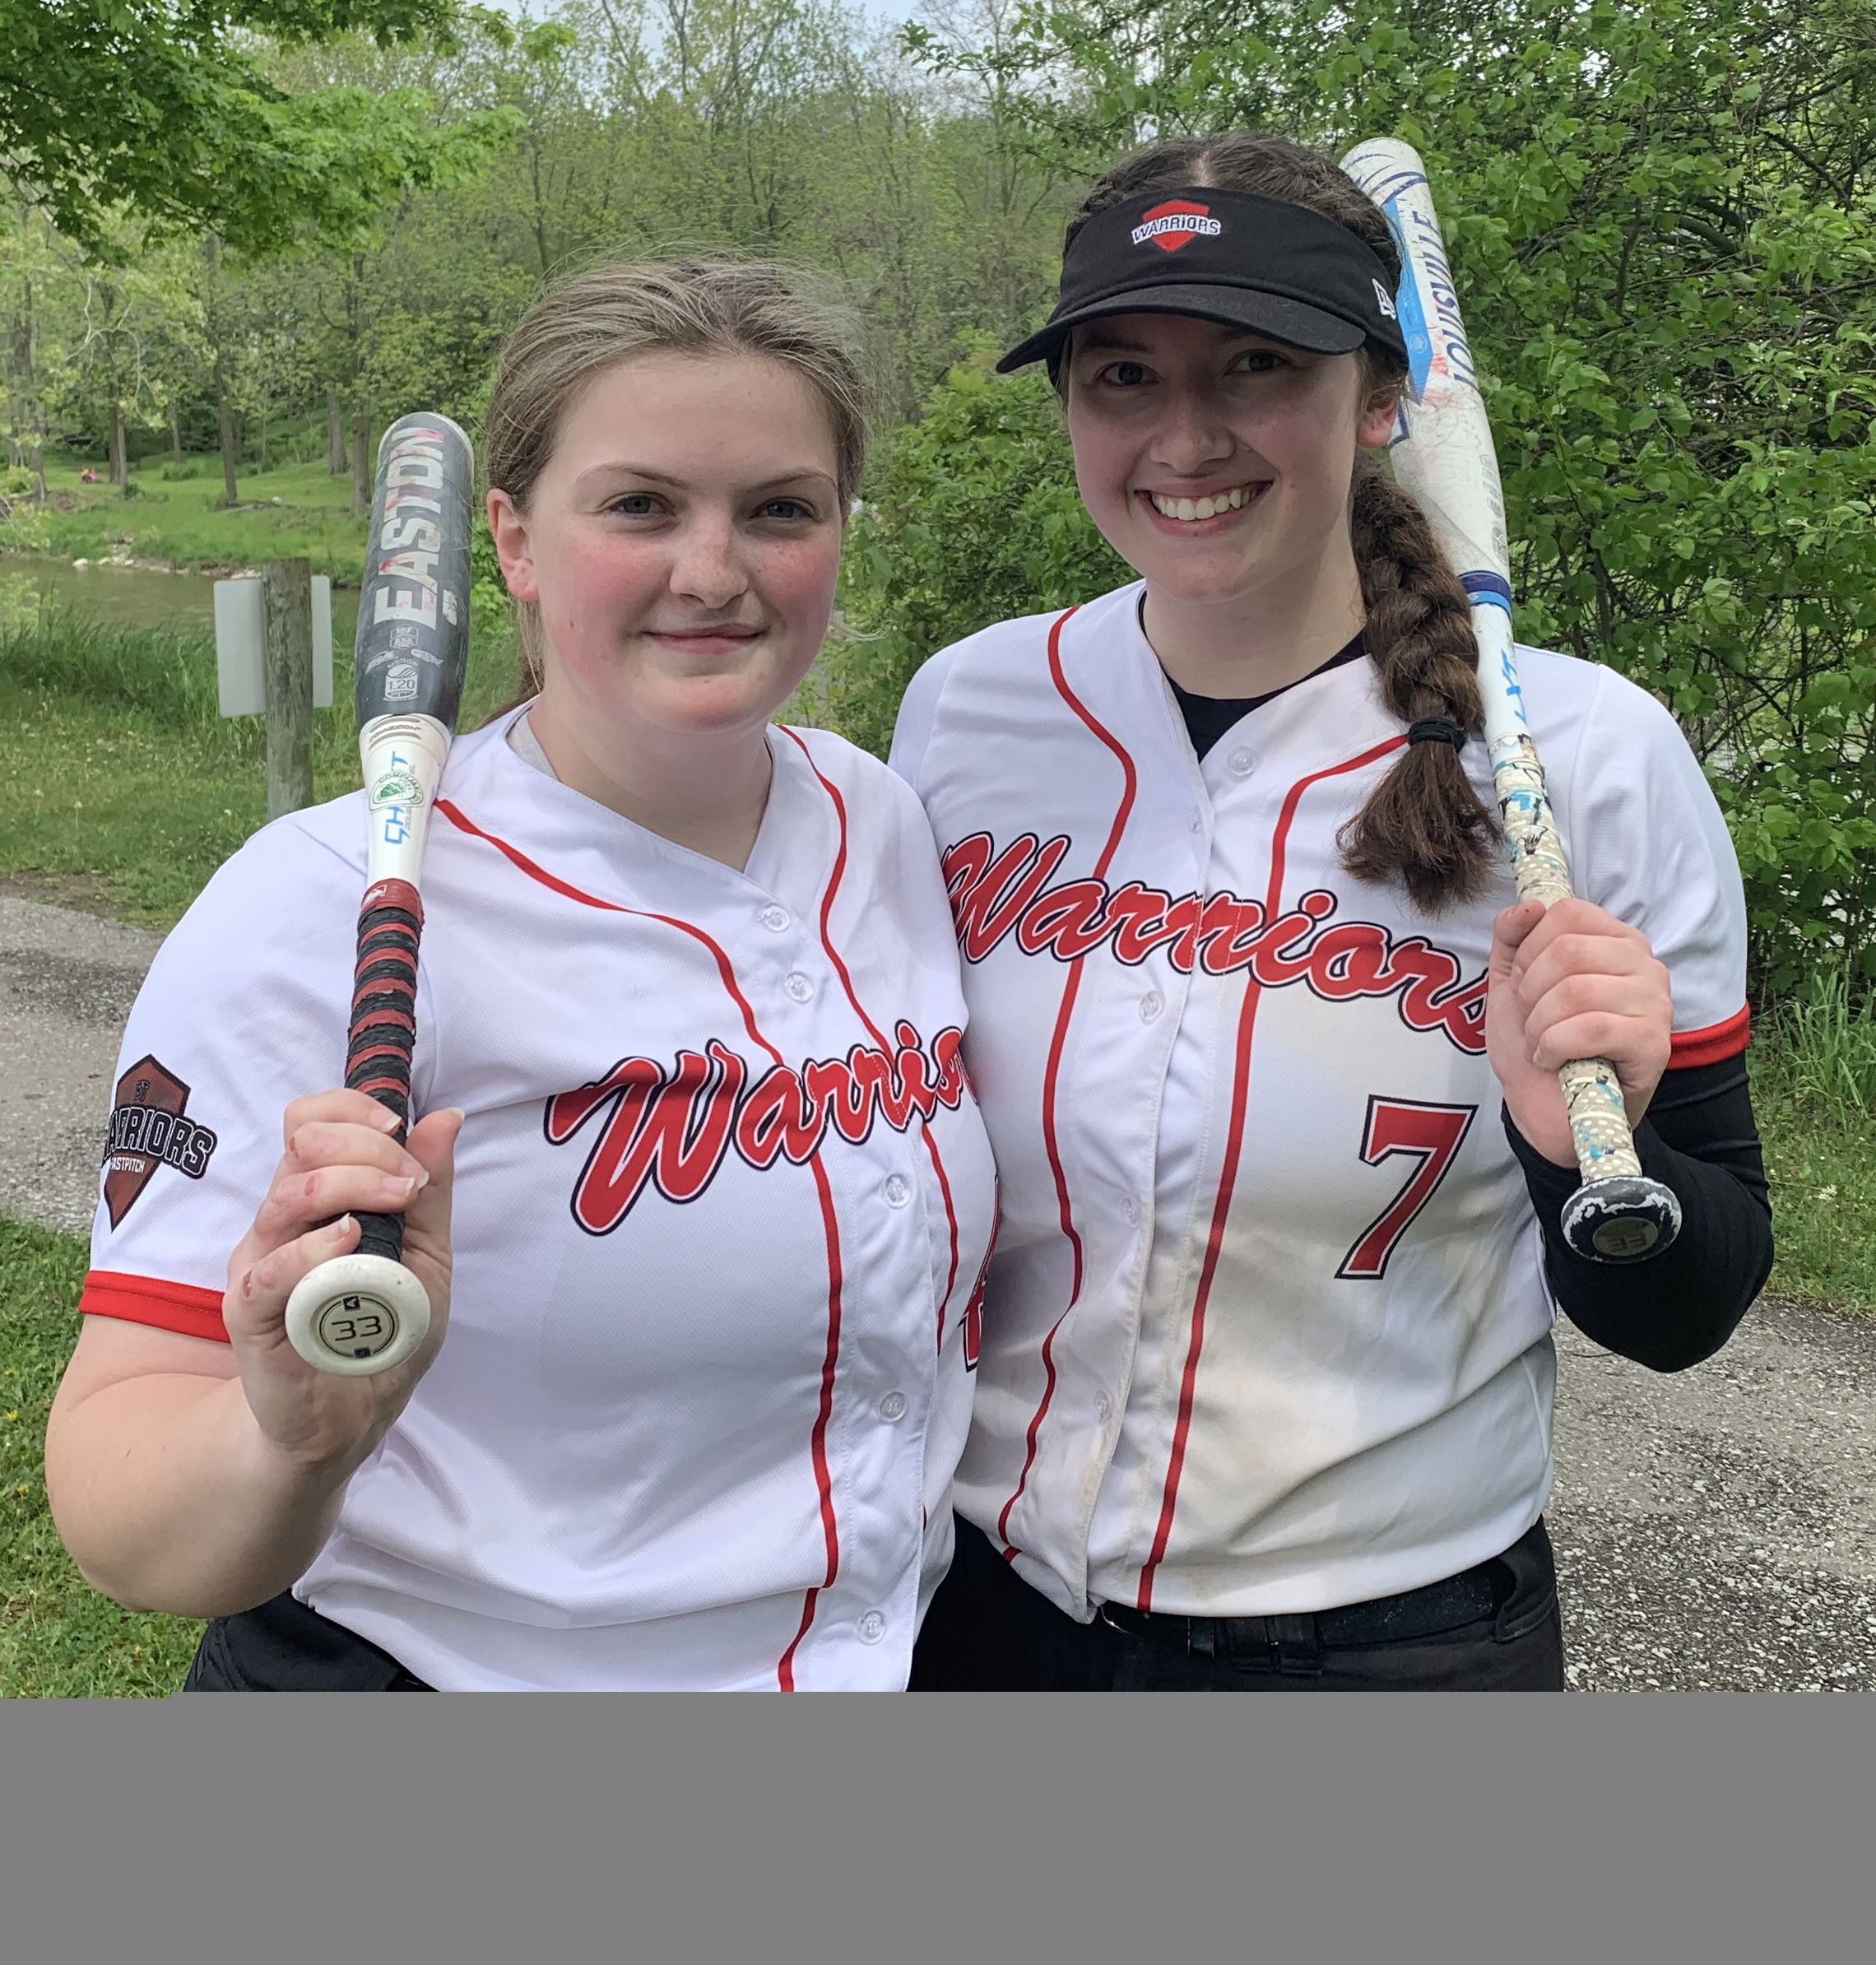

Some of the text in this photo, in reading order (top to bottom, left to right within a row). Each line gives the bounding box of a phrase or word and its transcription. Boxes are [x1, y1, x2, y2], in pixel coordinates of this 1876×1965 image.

[1132, 215, 1220, 244] WARRIORS
[374, 427, 444, 630] EASTON
[388, 679, 416, 691] 1.20
[384, 750, 411, 844] GHT
[942, 831, 1489, 1055] Warriors
[544, 1020, 979, 1236] Warrio
[1334, 1094, 1478, 1280] 7
[331, 1314, 383, 1342] 33
